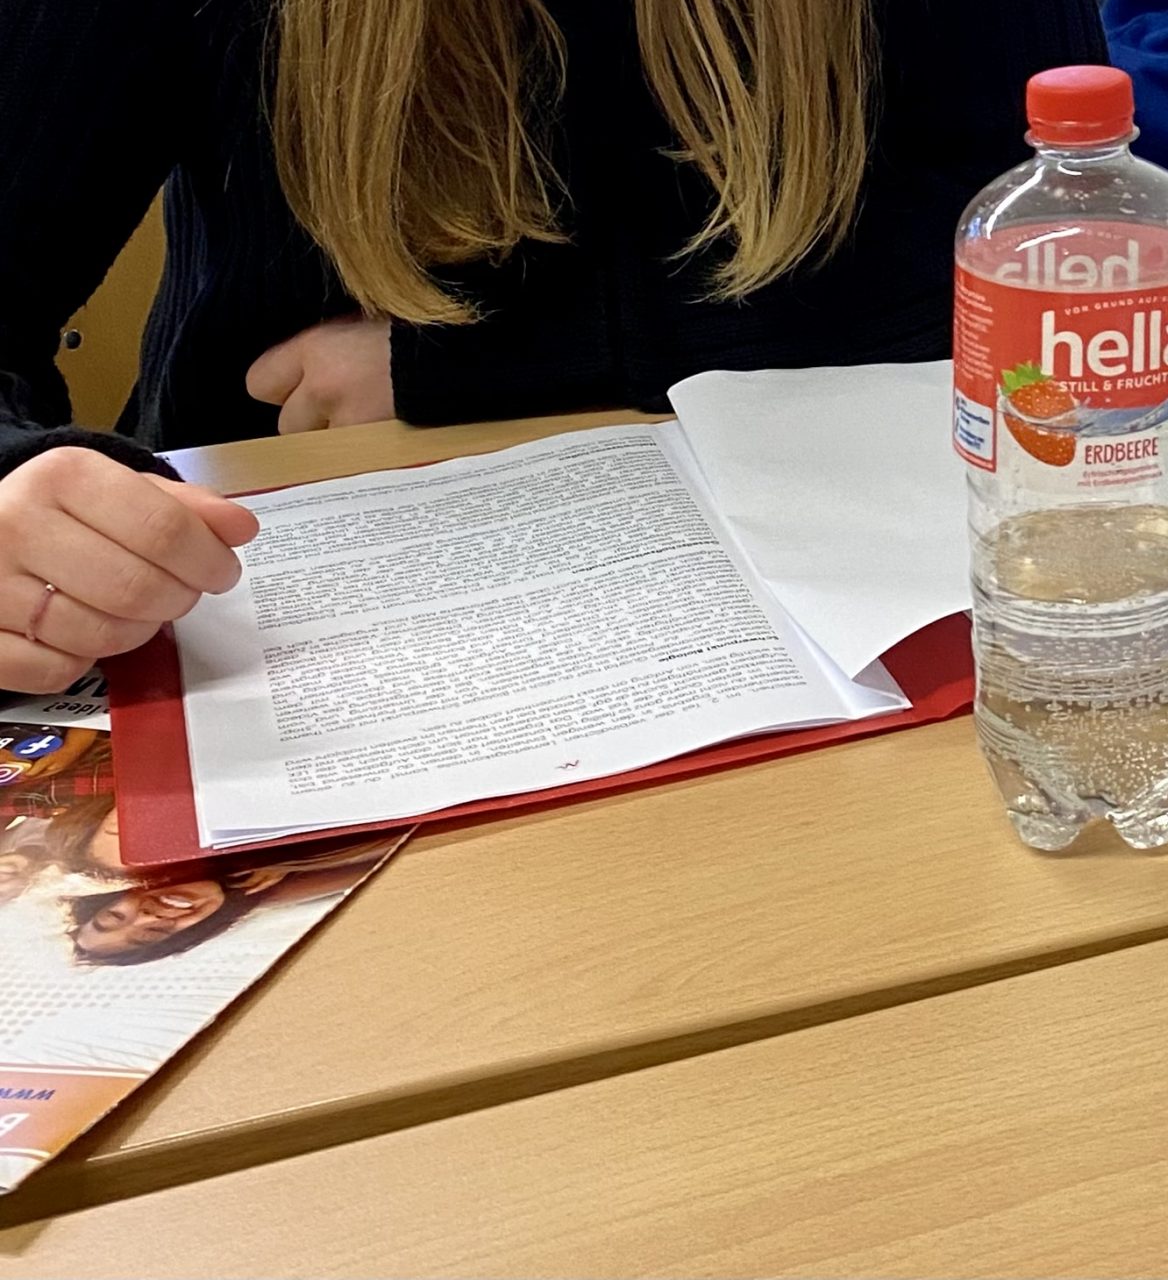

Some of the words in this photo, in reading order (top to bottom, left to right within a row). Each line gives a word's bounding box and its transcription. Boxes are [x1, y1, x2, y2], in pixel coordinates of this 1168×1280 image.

[1065, 306, 1088, 315] VON
[1095, 298, 1134, 310] GRUND
[1138, 296, 1158, 304] AUF
[1059, 381, 1099, 393] STILL
[1103, 380, 1112, 391] &
[1085, 437, 1159, 465] ERDBEERE
[708, 637, 779, 651] Schwerpunkt
[660, 650, 703, 662] Biologie
[43, 702, 102, 716] Idee?
